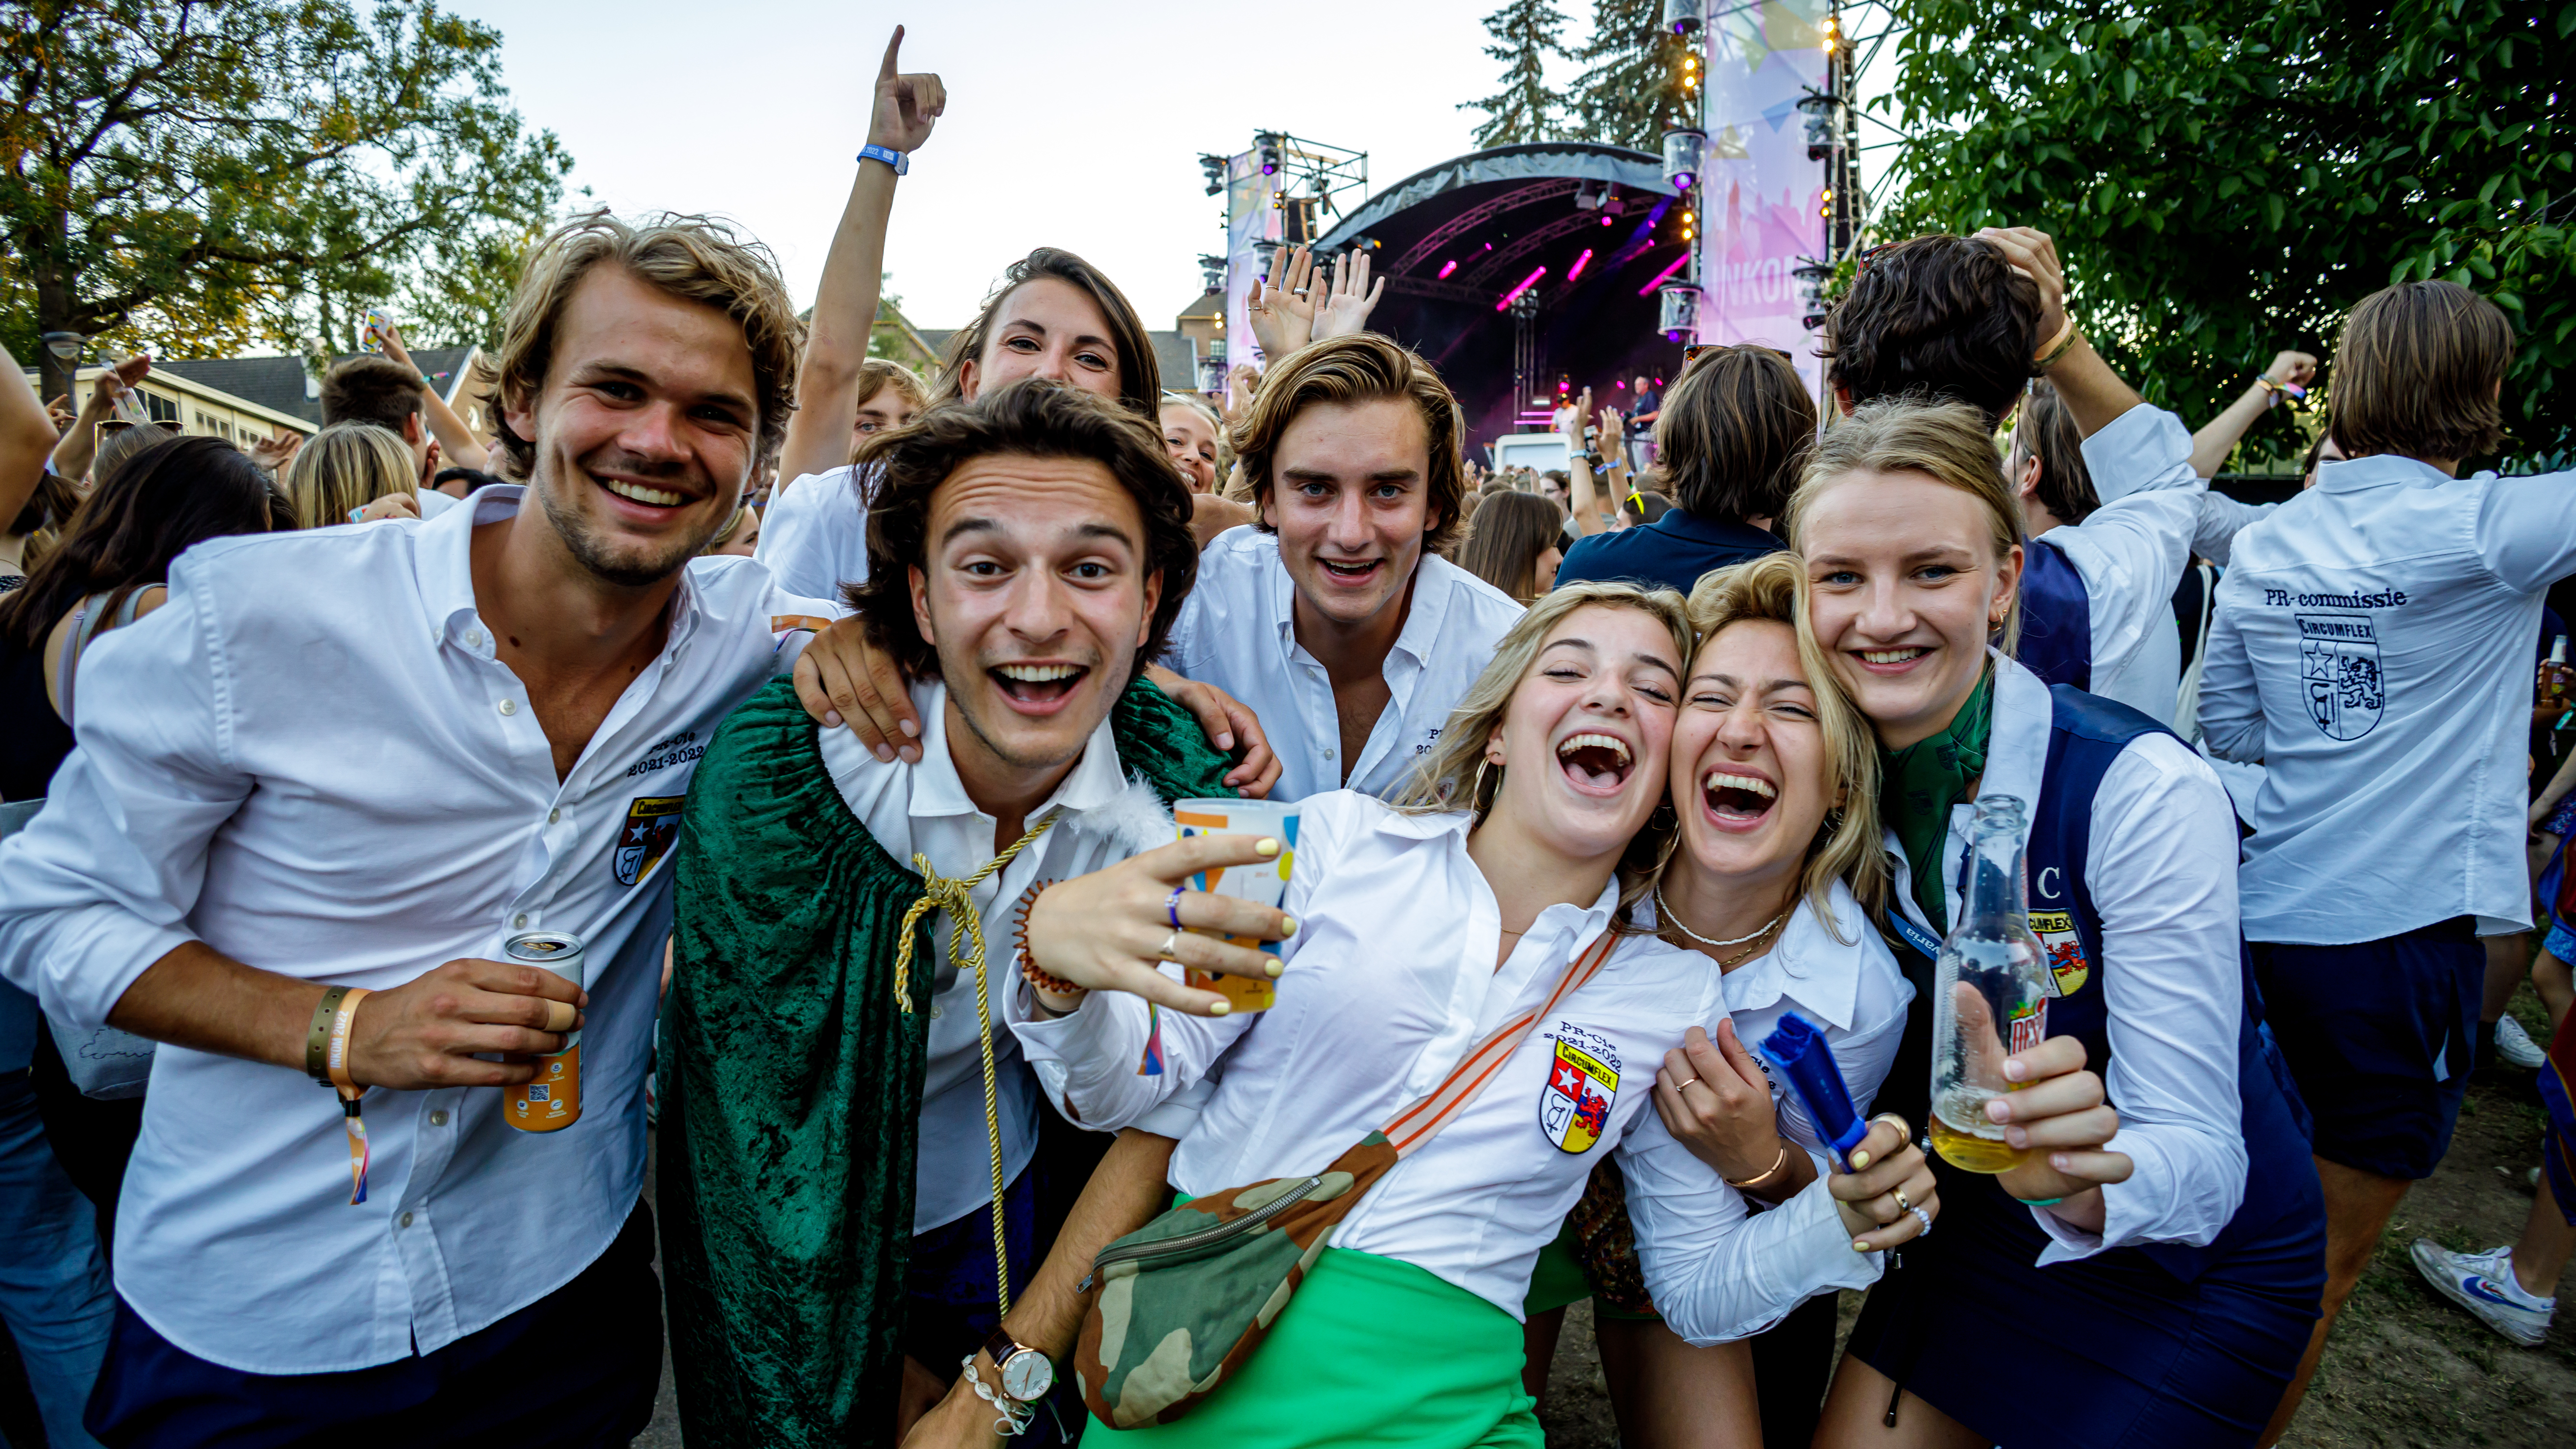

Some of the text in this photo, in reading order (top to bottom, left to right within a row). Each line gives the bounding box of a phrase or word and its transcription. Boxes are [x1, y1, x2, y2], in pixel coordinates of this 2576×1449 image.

[866, 146, 879, 155] 2022
[627, 745, 704, 777] 2021-2022
[2037, 867, 2060, 899] C
[2029, 917, 2074, 930] CUMFLEX
[1906, 927, 1940, 955] varia
[330, 1010, 349, 1069] INKOM 2022
[1544, 1033, 1622, 1073] 2021-2022
